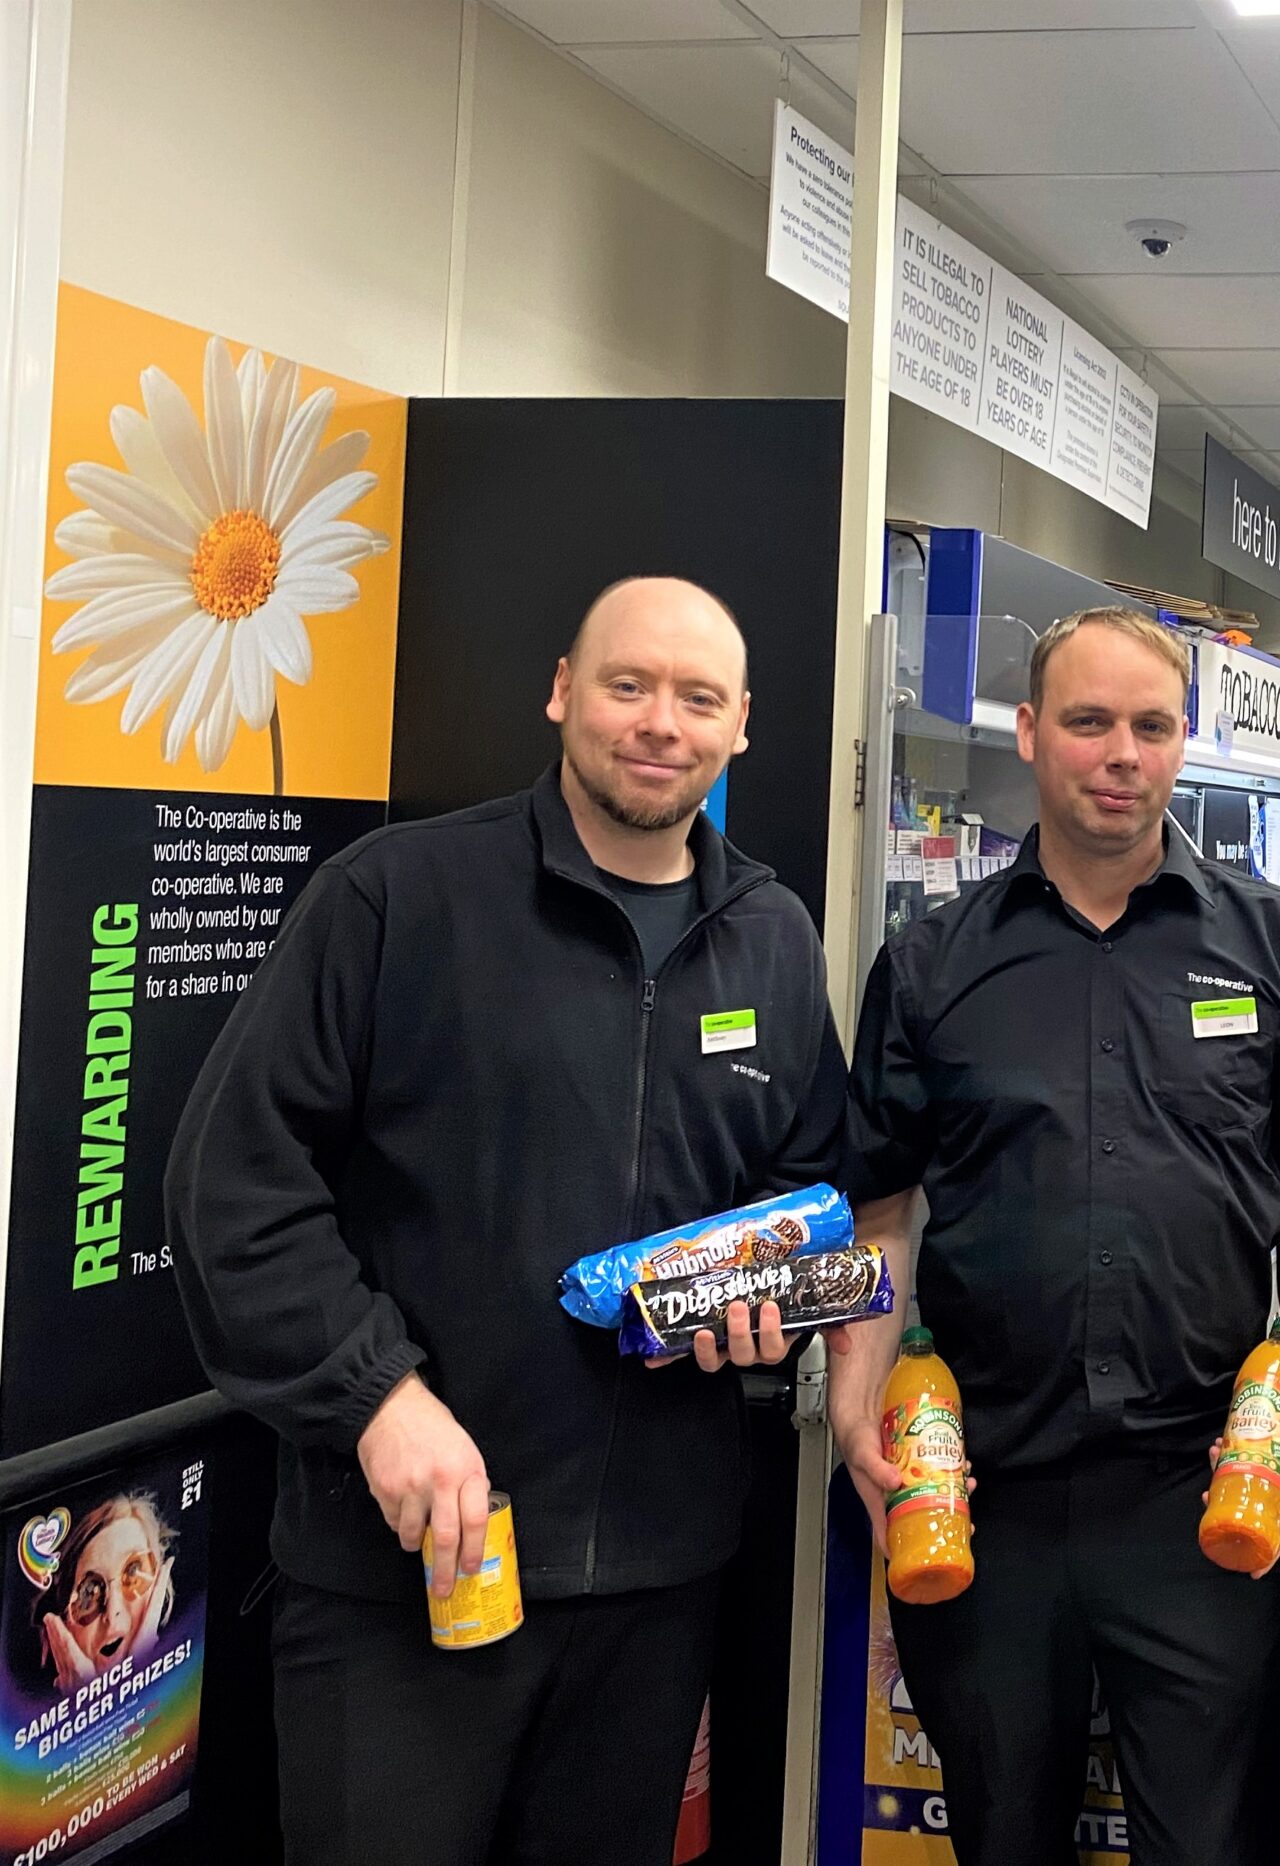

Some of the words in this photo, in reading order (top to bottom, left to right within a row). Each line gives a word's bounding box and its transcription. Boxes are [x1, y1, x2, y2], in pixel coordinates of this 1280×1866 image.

[791, 126, 835, 176] Protecting
[837, 165, 850, 183] our
[903, 227, 914, 250] IT
[916, 236, 926, 258] IS
[928, 246, 968, 287] ILLEGAL
[970, 273, 984, 296] TO
[902, 260, 927, 292] SELL
[931, 276, 980, 324] TOBACCO
[902, 292, 961, 343] PRODUCTS
[963, 326, 976, 351] TO
[1005, 297, 1048, 343] NATIONAL
[893, 319, 940, 361] ANYONE
[943, 348, 977, 382] UNDER
[1006, 326, 1044, 366] LOTTERY
[896, 352, 918, 380] THE
[920, 366, 941, 394] AGE
[944, 379, 959, 399] OF
[961, 387, 970, 408] 18
[991, 345, 1029, 384] PLAYERS
[1030, 370, 1053, 400] MUST
[997, 377, 1009, 399] BE
[1009, 386, 1034, 416] OVER
[1035, 401, 1043, 421] 18
[987, 399, 1016, 432] YEARS
[1017, 418, 1030, 438] OF
[1030, 427, 1047, 450] AGE
[1232, 478, 1262, 558] here
[1265, 505, 1276, 567] to
[156, 805, 181, 828] The
[186, 806, 266, 833] Co-operative
[270, 809, 279, 830] is
[283, 810, 301, 831] the
[206, 840, 248, 866] largest
[252, 845, 311, 862] consumer
[152, 873, 236, 899] co-operative.
[240, 872, 260, 894] We
[263, 876, 283, 894] are
[150, 907, 193, 933] wholly
[196, 905, 239, 928] owned
[243, 905, 257, 930] by
[261, 909, 281, 925] our
[148, 939, 212, 964] members
[216, 938, 242, 960] who
[245, 941, 266, 959] are
[146, 975, 165, 998] for
[169, 979, 177, 997] a
[181, 973, 218, 996] share
[222, 971, 233, 992] in
[1187, 973, 1201, 983] The
[1203, 976, 1253, 992] co-operative
[73, 903, 139, 1290] REWARDING
[130, 1251, 156, 1275] The
[661, 1264, 793, 1325] Digestives
[1232, 1417, 1276, 1432] Barley
[182, 1460, 204, 1479] STILL
[182, 1470, 203, 1488] ONLY
[181, 1480, 201, 1510] £1
[14, 1698, 70, 1749] SAME
[76, 1656, 133, 1710] PRICE
[38, 1694, 113, 1759] BIGGER
[120, 1639, 192, 1703] PRIZES!
